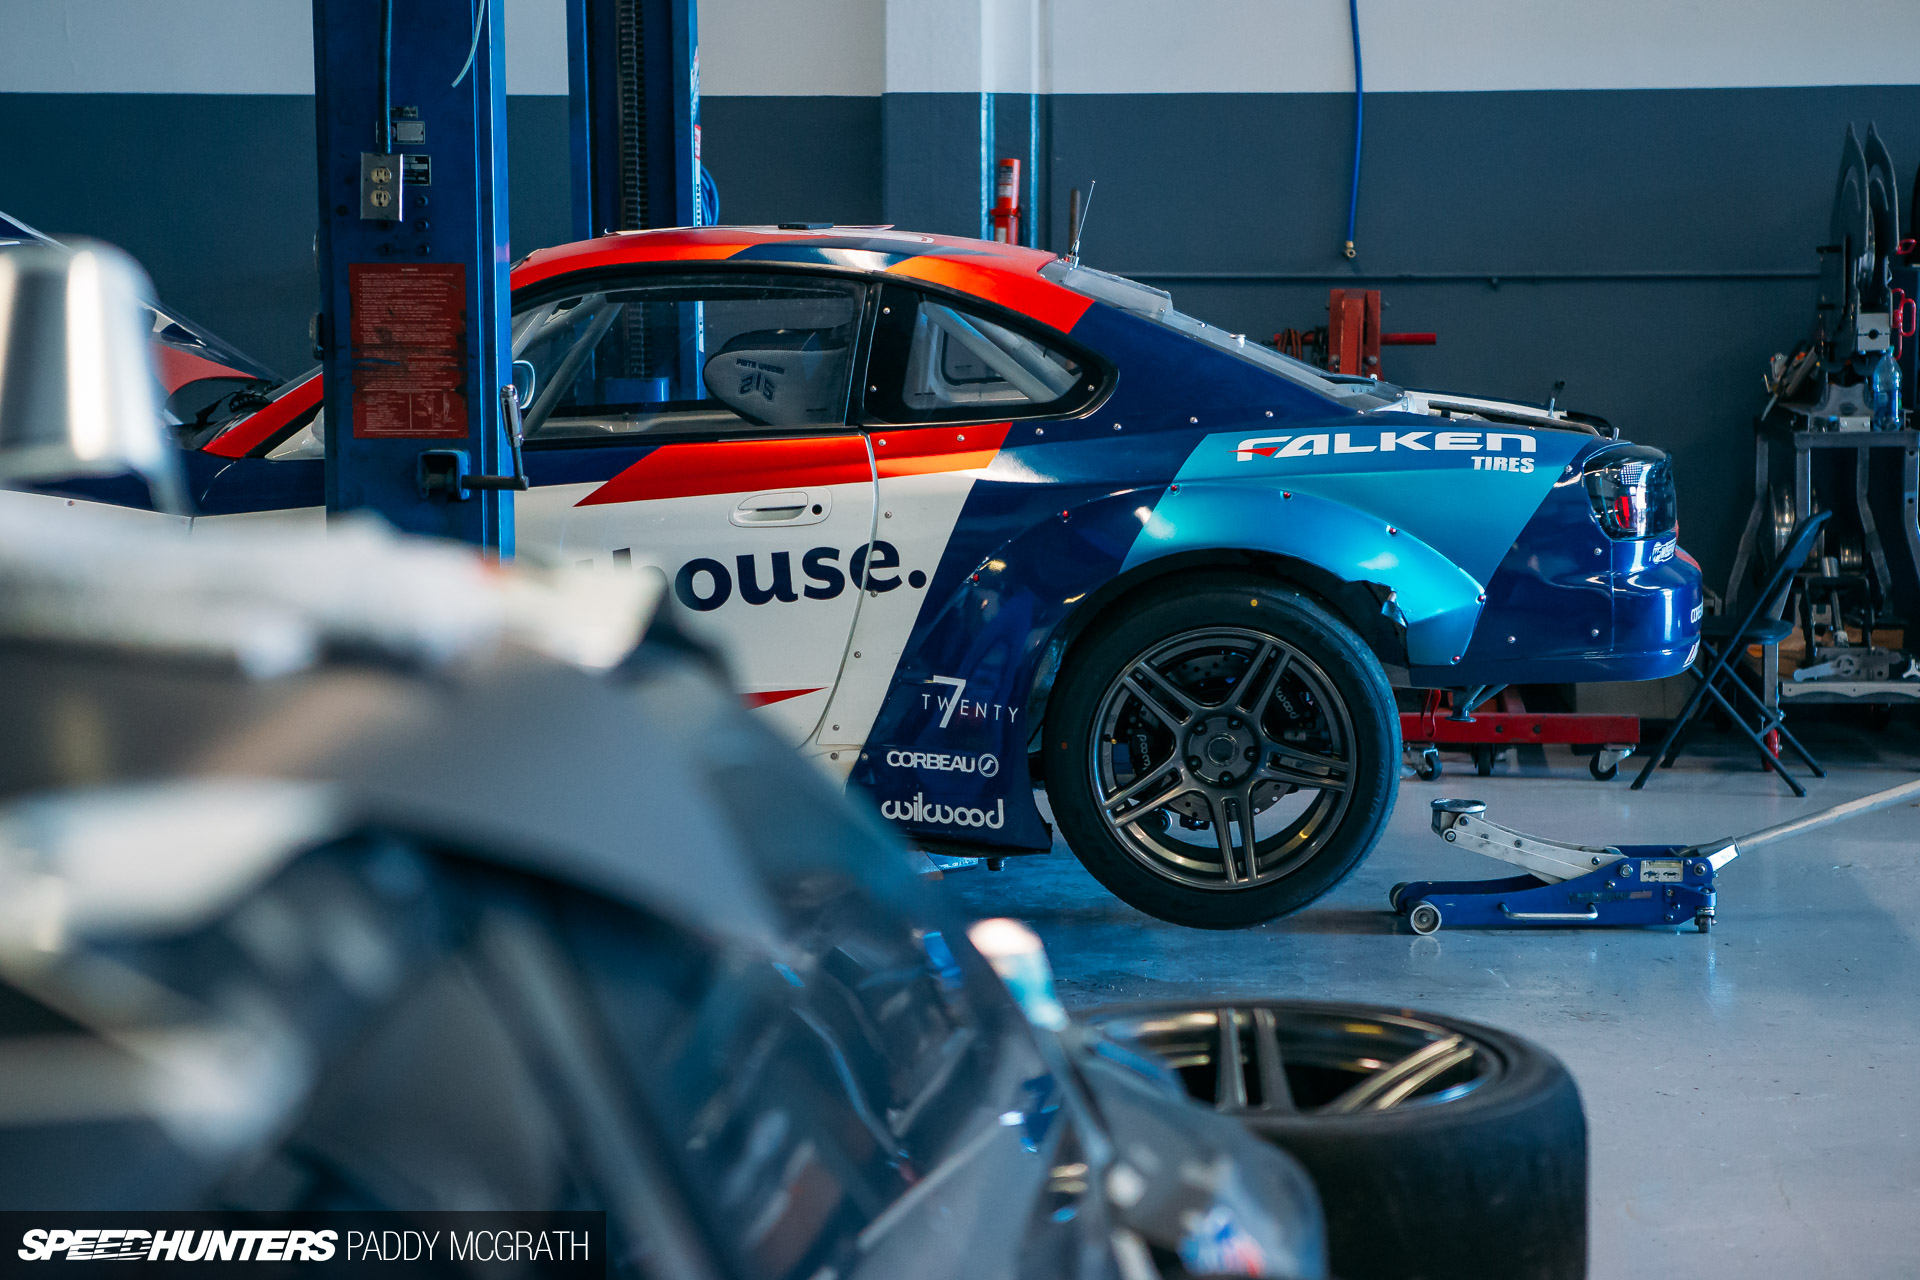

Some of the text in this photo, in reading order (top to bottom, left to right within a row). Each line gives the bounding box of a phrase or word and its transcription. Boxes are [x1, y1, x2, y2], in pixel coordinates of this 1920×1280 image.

[1237, 431, 1537, 462] FALKEN
[1471, 456, 1535, 474] TIRES
[576, 540, 927, 612] ouse.
[922, 694, 1019, 723] TWENTY
[933, 675, 967, 728] 7
[886, 751, 976, 773] CORBEAU
[881, 792, 1005, 830] wilwood
